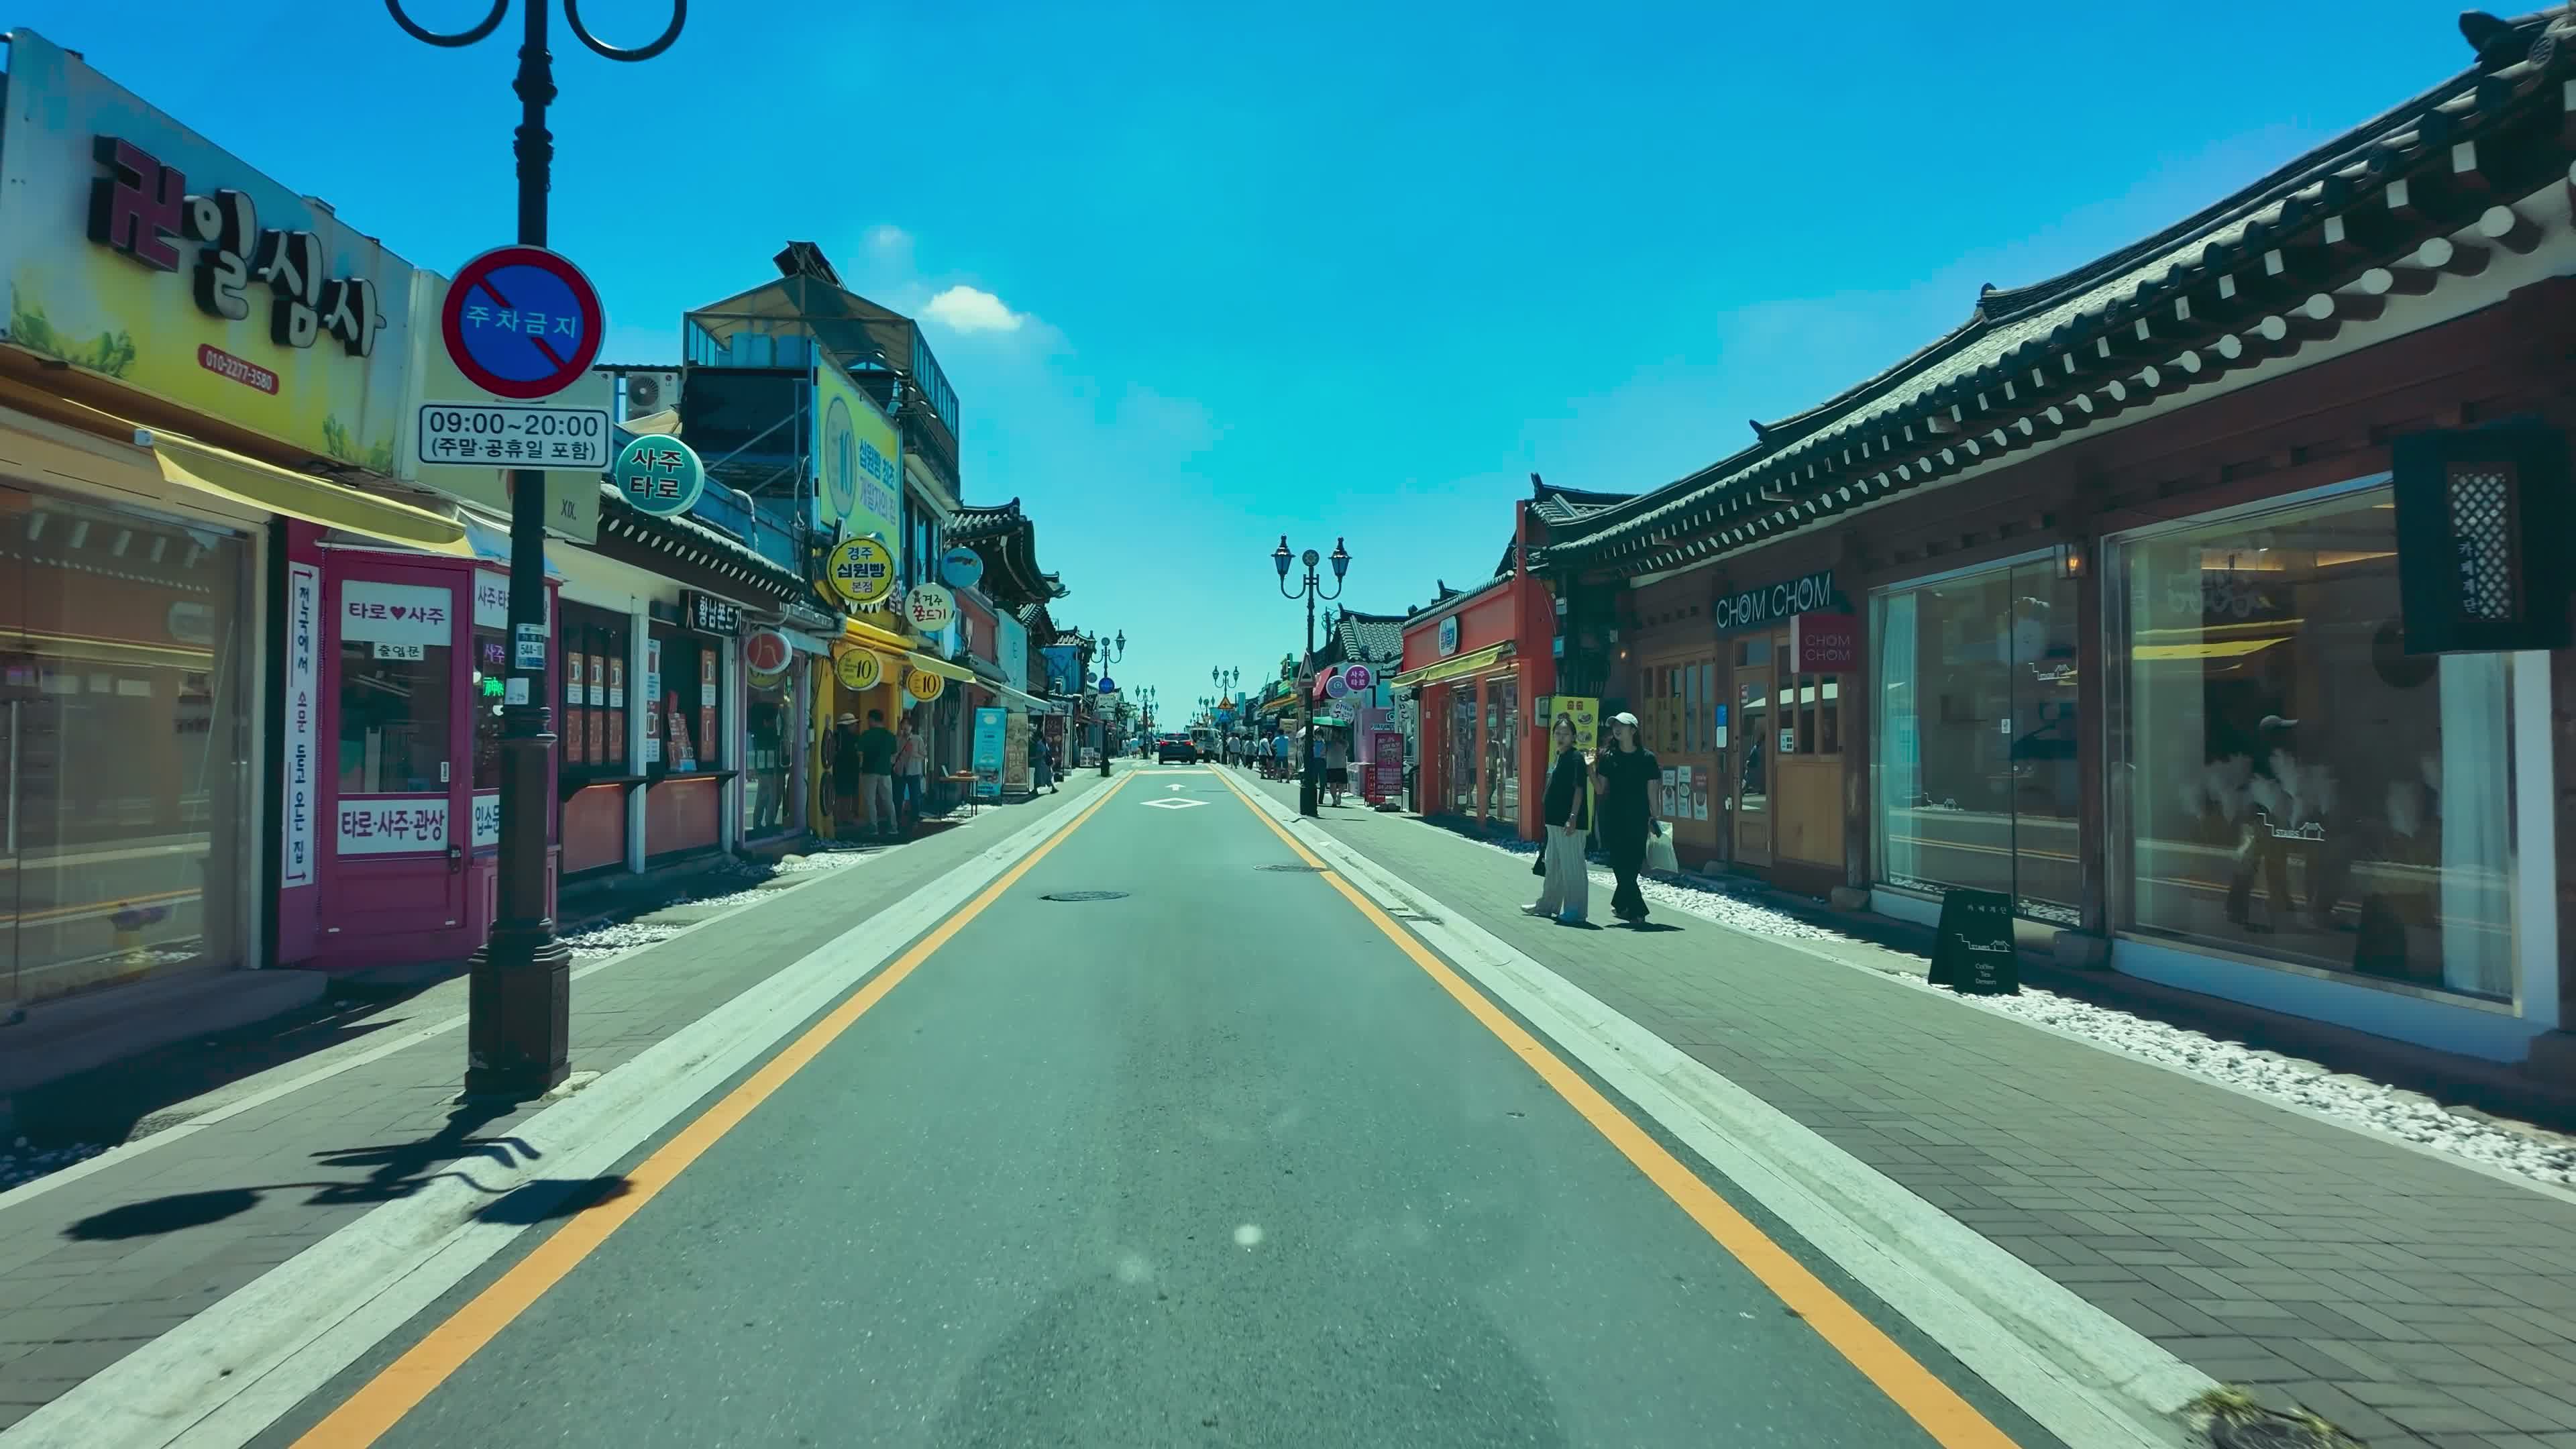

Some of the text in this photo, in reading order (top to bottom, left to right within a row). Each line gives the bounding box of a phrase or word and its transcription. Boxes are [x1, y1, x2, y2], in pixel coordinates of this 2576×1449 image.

[183, 189, 387, 358] 일심사
[466, 306, 577, 338] 주차금지
[429, 411, 598, 437] 09:00~20:00
[551, 441, 596, 461] 포함)
[629, 448, 685, 474] 사주
[859, 438, 881, 481] 십원빵
[629, 476, 682, 500] 타로
[848, 547, 873, 560] 경주
[837, 563, 885, 578] 십원빵
[853, 580, 873, 593] 본점
[478, 586, 510, 610] 사주·타
[922, 594, 943, 606] 경주
[1717, 572, 1831, 629] CHOM CHOM
[349, 602, 445, 625] 타로 사주
[912, 605, 946, 623] 쫀드기
[297, 586, 309, 674] 전국에서
[1805, 634, 1850, 647] CHOM
[378, 645, 419, 657] 출입문
[1805, 649, 1851, 661] CHOM
[857, 659, 871, 679] 10
[1351, 670, 1365, 678] 사주
[923, 675, 936, 693] 10
[297, 692, 308, 733] 소문
[342, 810, 445, 841] 타로·사주·관상
